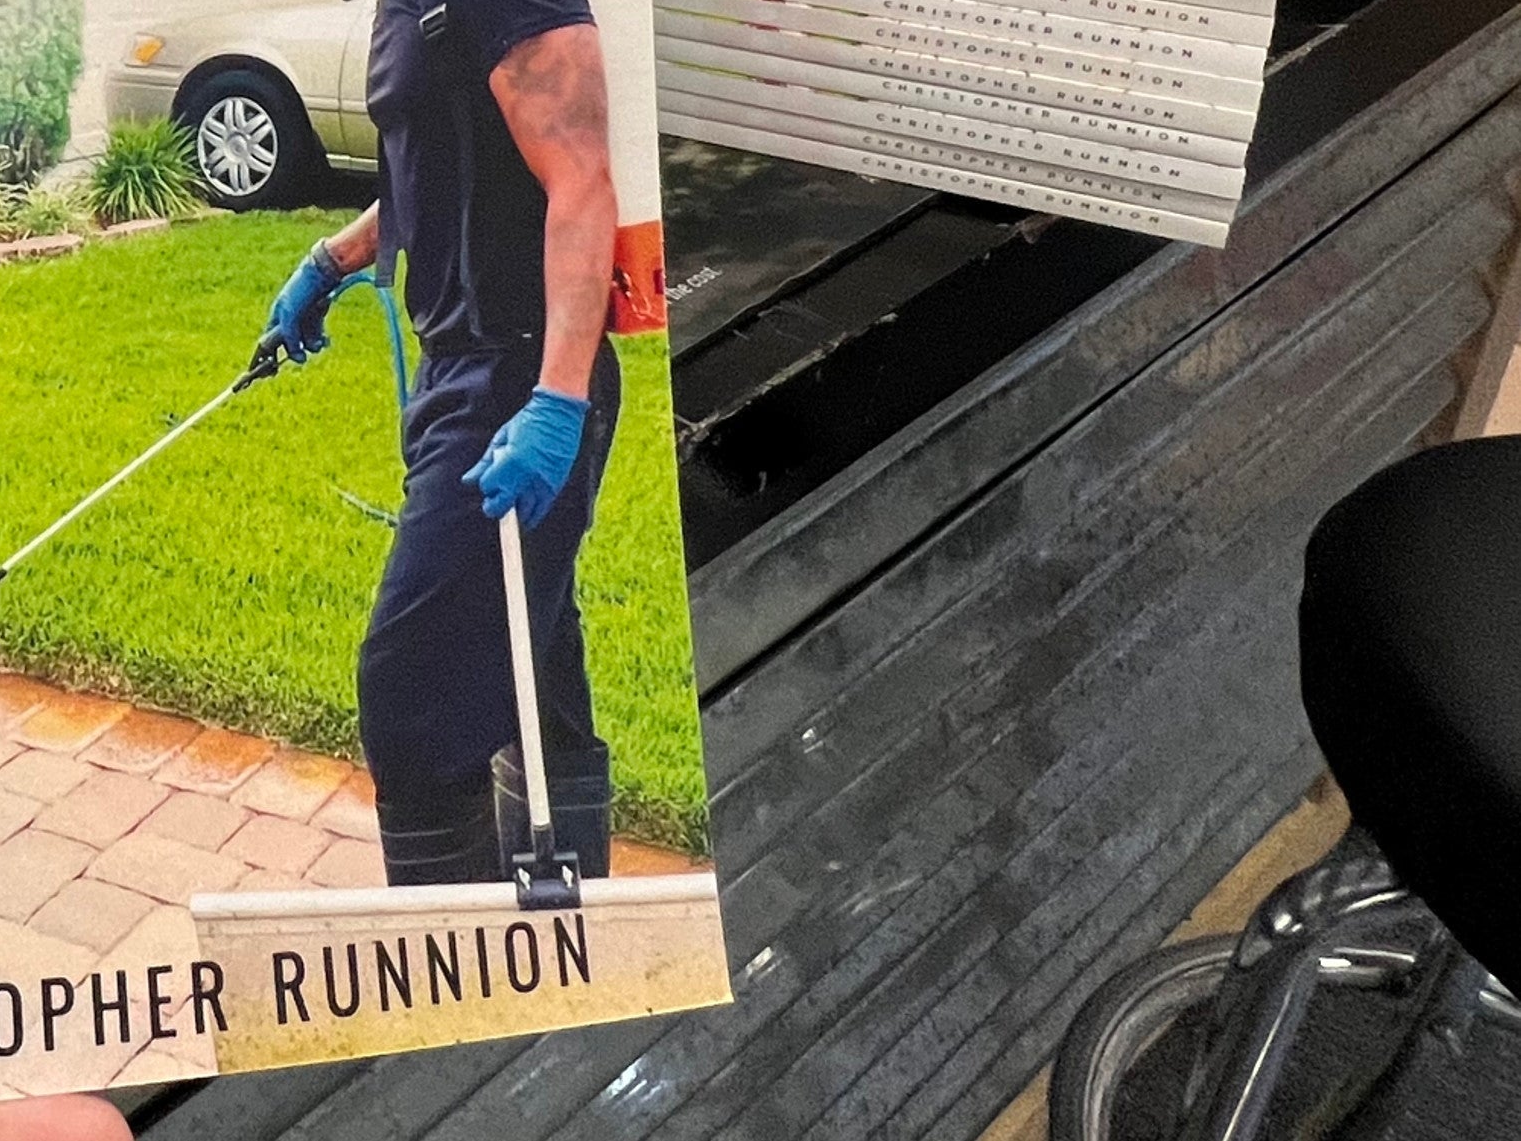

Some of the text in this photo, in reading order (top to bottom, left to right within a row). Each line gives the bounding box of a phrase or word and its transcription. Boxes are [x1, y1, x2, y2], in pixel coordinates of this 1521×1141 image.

[875, 28, 1183, 89] CHRISTOPHER RUNNION
[883, 0, 1193, 58] CHRISTOPHER RUNNION
[869, 57, 1175, 120] CHRISTOPHER RUNNION
[882, 81, 1190, 145] CHRISTOPHER RUNNION
[863, 136, 1162, 201] CHRISTOPHER RUNNION
[876, 113, 1181, 178] CHRISTOPHER RUNNION
[862, 156, 1161, 224] CHRISTOPHER RUNNION
[272, 914, 591, 1026] RUNNION
